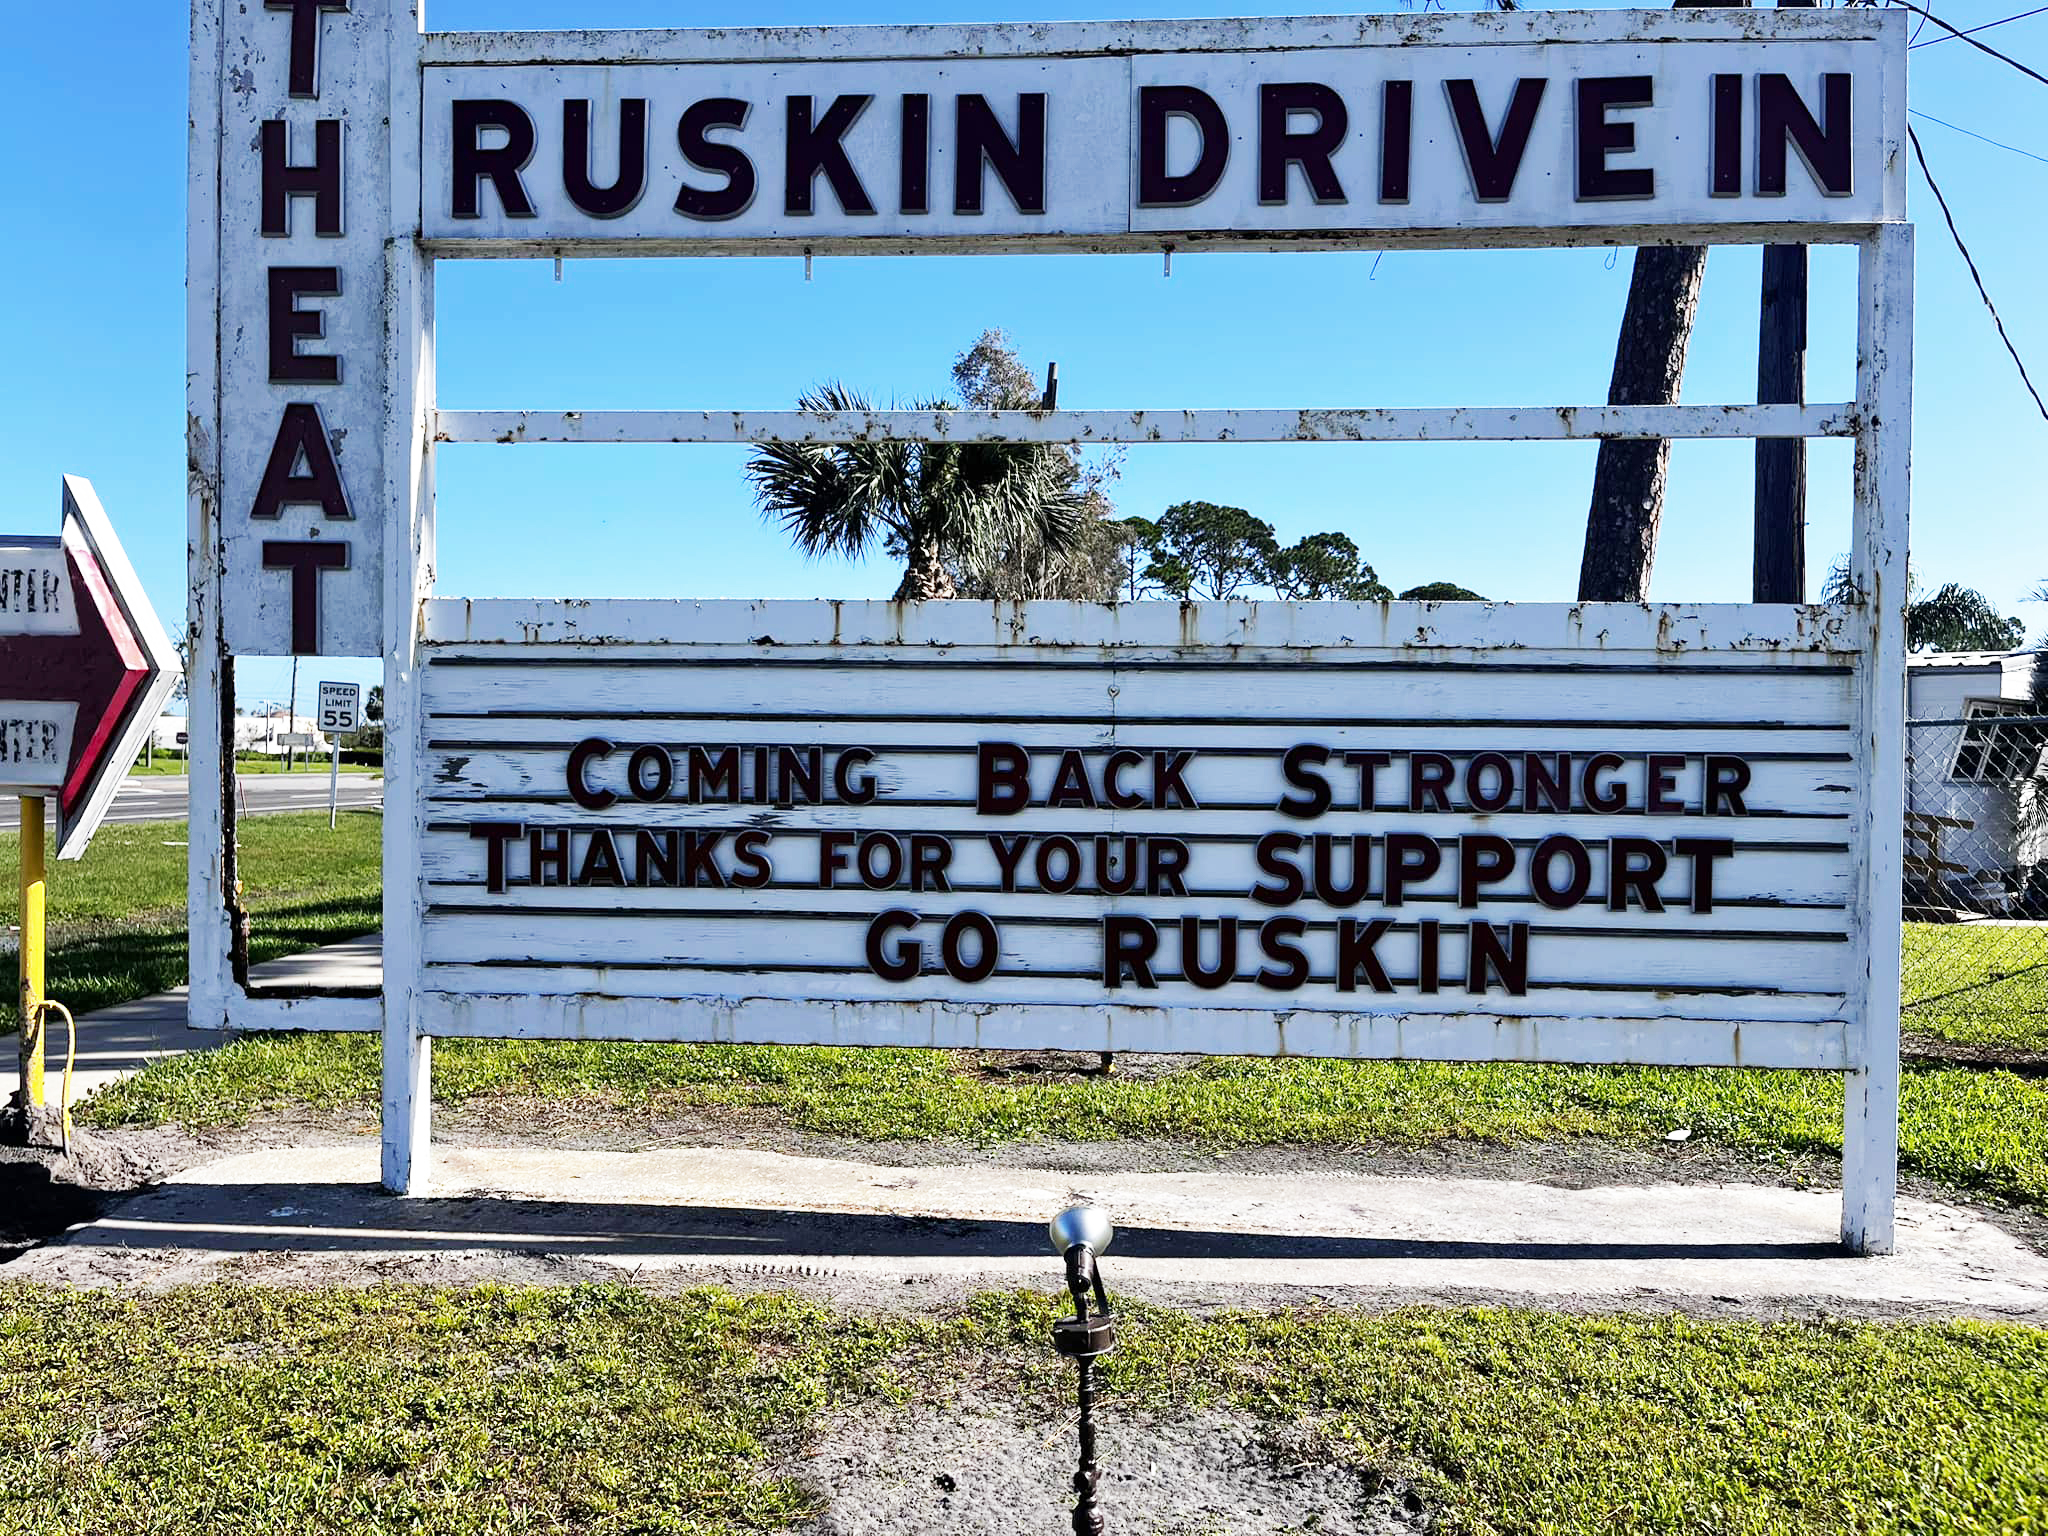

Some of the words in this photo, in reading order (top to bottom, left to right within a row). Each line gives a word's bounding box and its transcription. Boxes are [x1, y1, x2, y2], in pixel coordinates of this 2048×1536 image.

[451, 92, 1048, 221] RUSKIN
[1136, 75, 1655, 208] DRIVE
[1709, 72, 1855, 198] IN
[250, 0, 356, 655] THEAT
[322, 686, 356, 697] SPEED
[323, 710, 353, 728] 55
[325, 698, 352, 708] LIMIT
[566, 737, 879, 811] COMING
[976, 740, 1199, 816] BACK
[1276, 743, 1752, 820] STRONGER
[469, 822, 773, 894] THANKS
[818, 830, 953, 893] FOR
[986, 833, 1190, 897] YOUR
[1249, 832, 1737, 915] SUPPORT
[865, 907, 1000, 984] GO
[1102, 913, 1531, 997] RUSKIN
